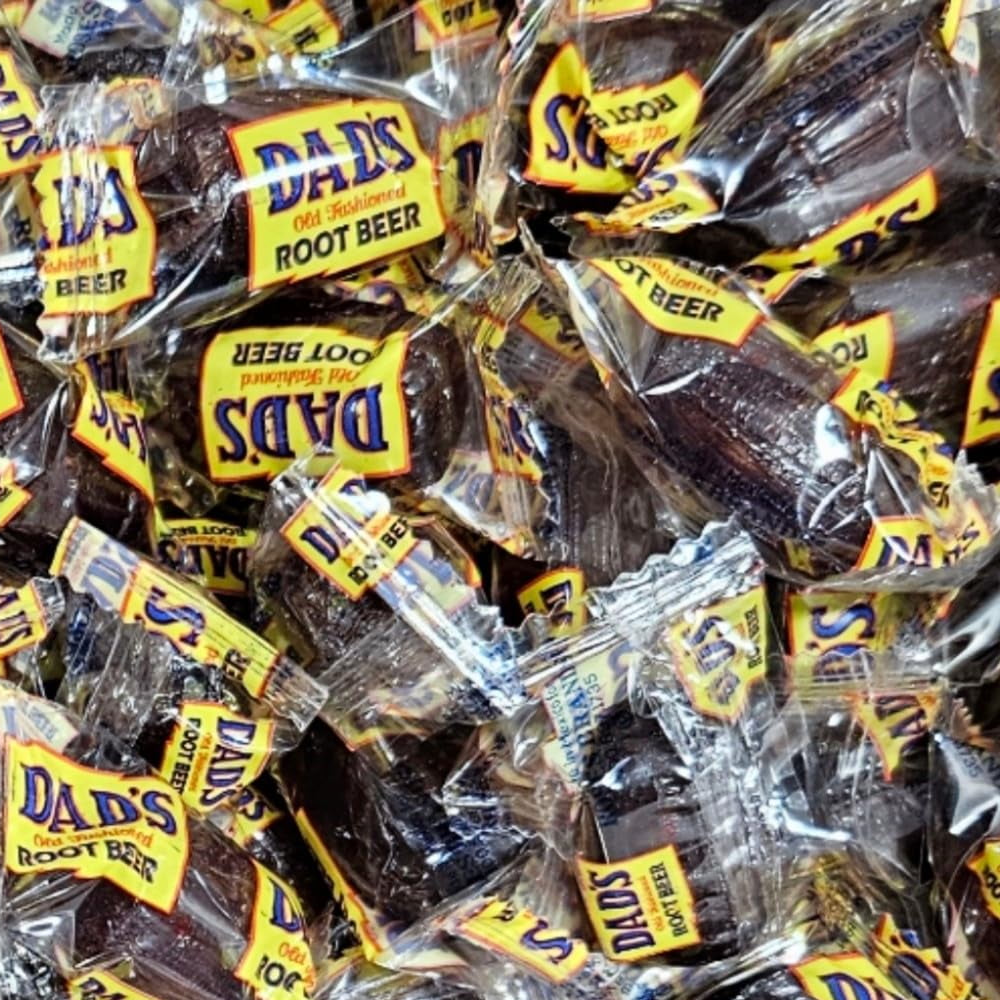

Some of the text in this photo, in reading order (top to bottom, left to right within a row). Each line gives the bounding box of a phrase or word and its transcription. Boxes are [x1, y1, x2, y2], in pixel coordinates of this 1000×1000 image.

[606, 93, 679, 129] ROOT
[254, 112, 417, 217] DAD'S
[275, 201, 422, 273] ROOT BEER
[292, 184, 407, 232] Old Fashioned
[648, 283, 726, 323] BEER
[232, 341, 304, 366] BEER
[240, 367, 324, 390] Fashioned
[214, 384, 389, 466] DAD'S
[20, 759, 177, 835] DAD'S
[203, 716, 257, 808] DAD'S
[17, 841, 159, 884] ROOT BEER
[594, 867, 656, 954] DAD'S
[650, 861, 689, 937] ROOT BEER
